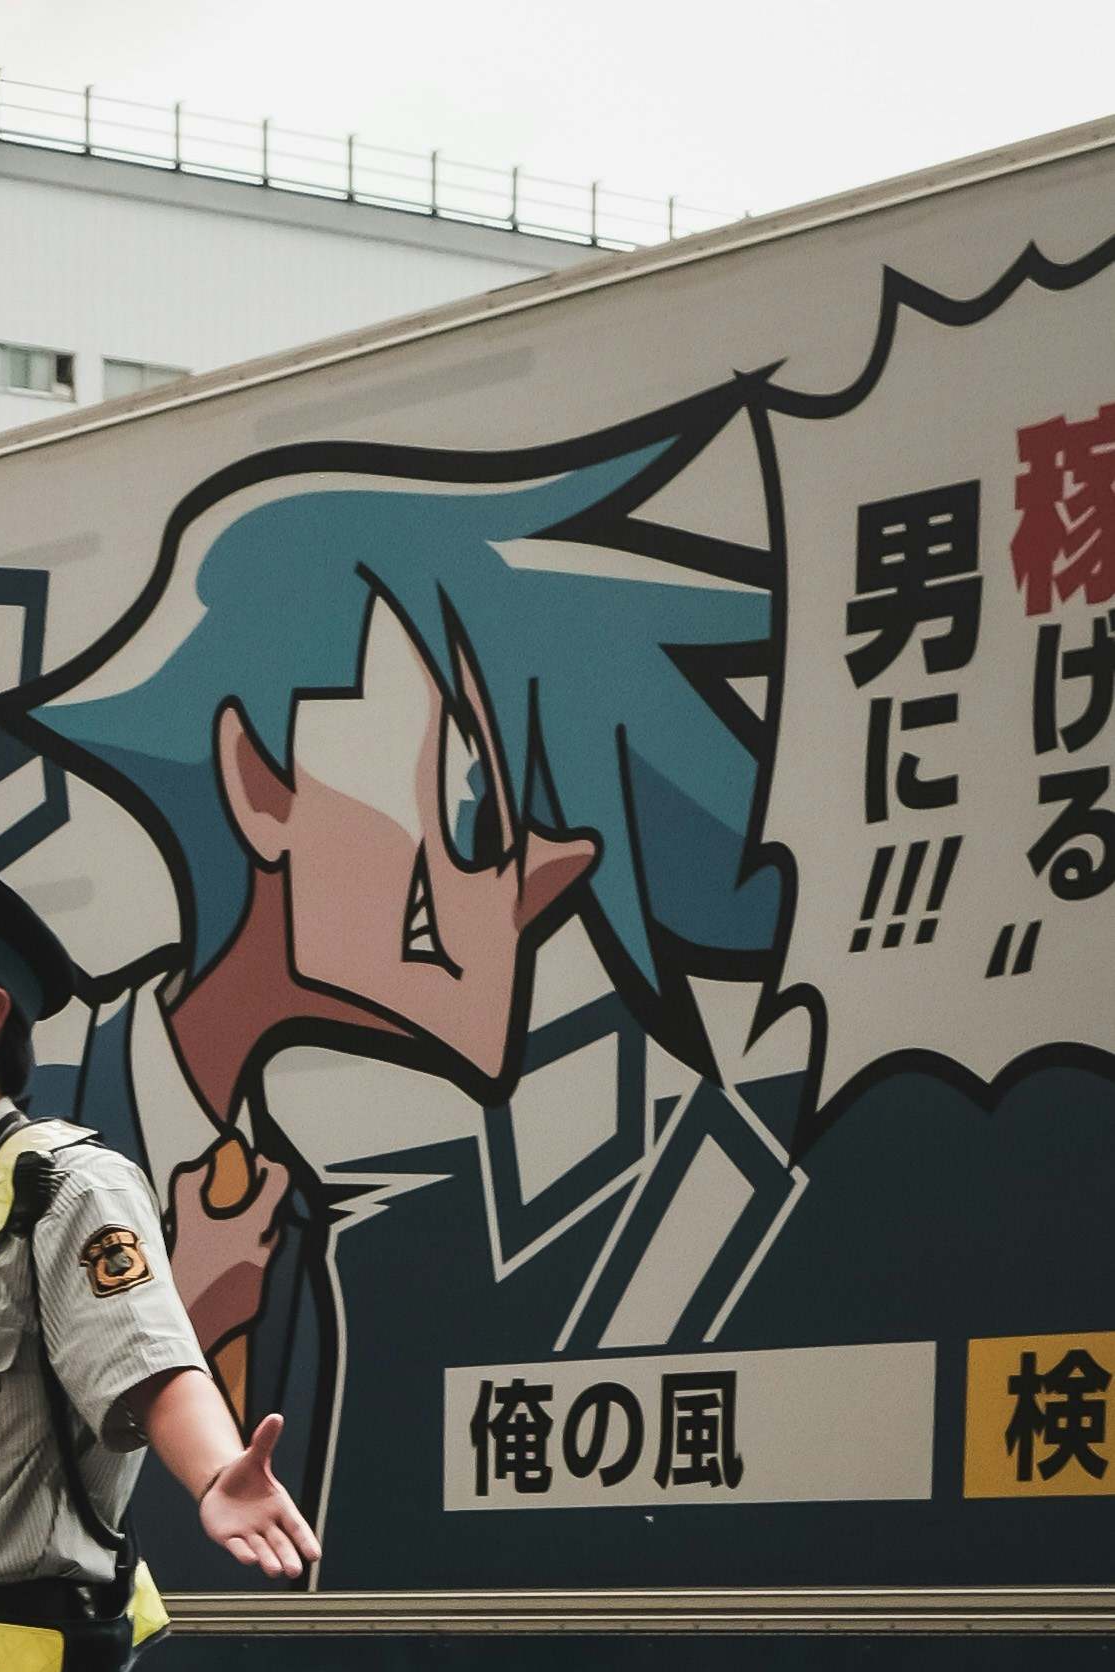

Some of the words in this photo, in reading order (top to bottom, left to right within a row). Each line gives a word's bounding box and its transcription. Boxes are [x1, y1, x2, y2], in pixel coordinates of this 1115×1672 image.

[844, 479, 983, 954] 男に!!!
[469, 1370, 744, 1497] 俺の風
[1004, 1349, 1113, 1483] 検
